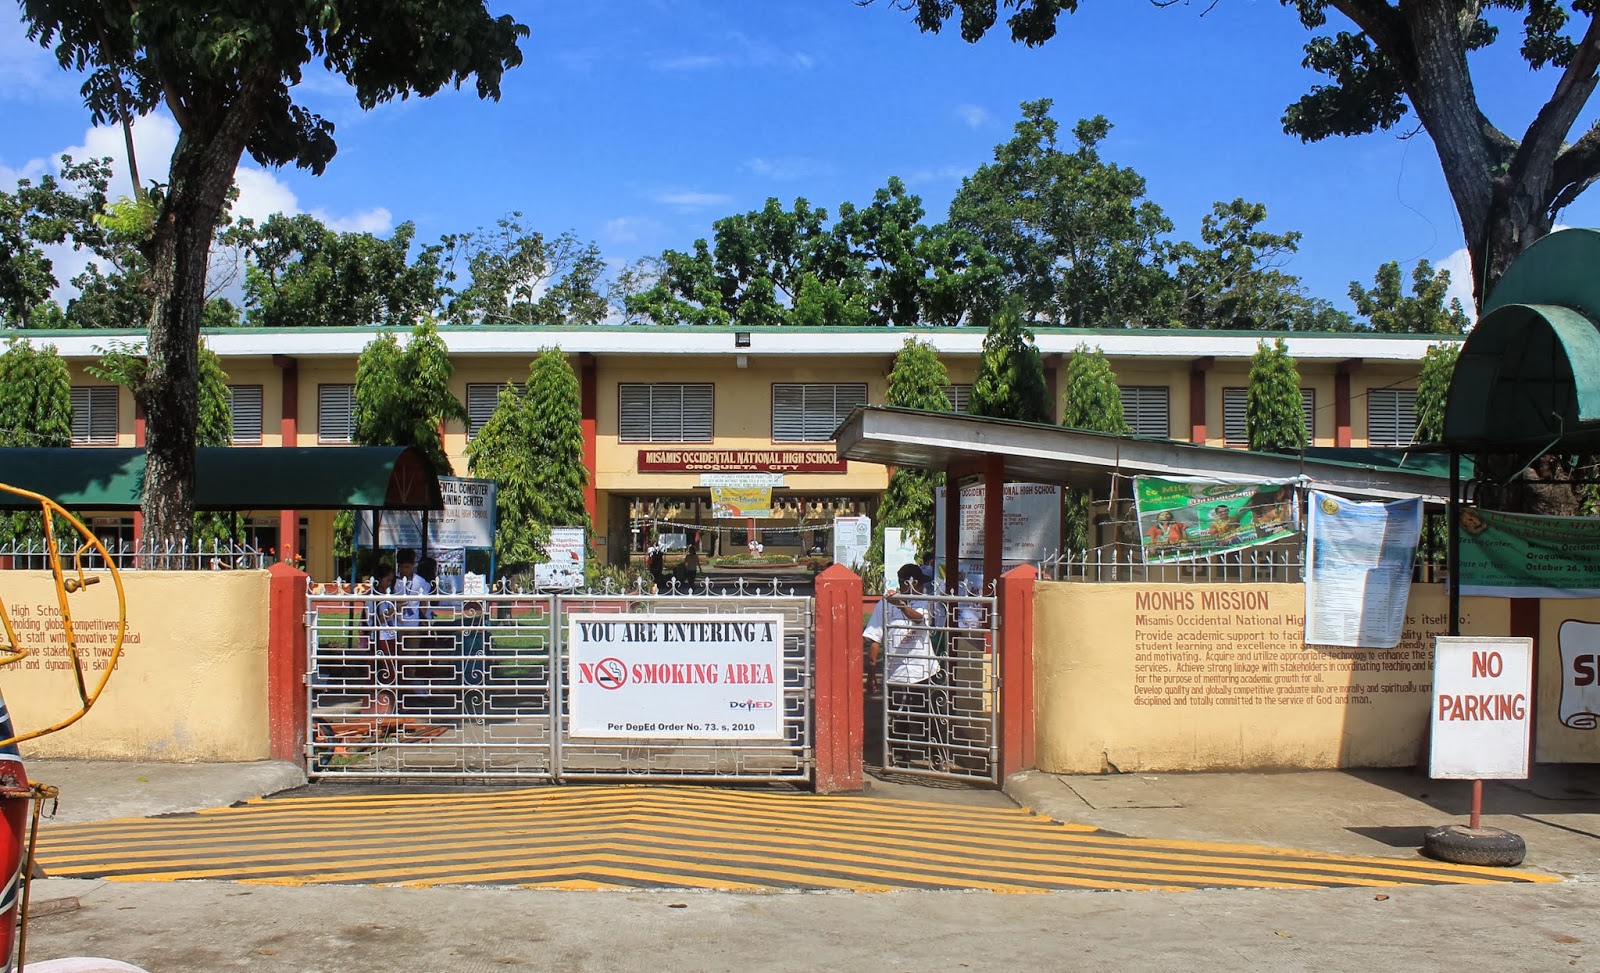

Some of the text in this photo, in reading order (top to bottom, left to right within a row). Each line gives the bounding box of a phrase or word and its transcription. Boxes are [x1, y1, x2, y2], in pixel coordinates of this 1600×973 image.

[646, 451, 839, 464] MISAMIS OCCIDENTAL NATIONAL HIGH SCHOOL
[440, 482, 488, 495] ENTAL COMPUTER
[1034, 486, 1056, 494] SCHOOL
[442, 495, 484, 506] AINING CENTER
[1562, 544, 1600, 552] Occident
[1526, 563, 1563, 572] October
[1136, 591, 1269, 610] MONHS MISSION
[12, 604, 62, 617] High Schoo
[10, 618, 130, 631] pholding globa ompetitivenes
[1136, 615, 1174, 626] Misamis
[1176, 614, 1231, 626] Occidental
[1236, 614, 1282, 626] National
[1286, 614, 1305, 628] Hig
[1422, 614, 1447, 624] itself
[1460, 614, 1470, 624] o:
[26, 632, 46, 643] staff
[50, 632, 66, 643] with
[74, 632, 108, 644] novative
[109, 632, 140, 644] tenical
[580, 622, 773, 642] YOU ARE ENTERING A
[1136, 630, 1172, 640] Provide
[1176, 630, 1224, 640] academic
[1227, 632, 1264, 642] support
[1270, 632, 1279, 640] to
[1282, 630, 1305, 640] facili
[1402, 630, 1422, 644] ality
[43, 646, 90, 657] stakehers
[93, 646, 125, 658] towas
[1136, 642, 1172, 650] student
[1176, 642, 1212, 652] learning
[1216, 642, 1232, 650] and
[1236, 642, 1286, 650] excellence
[1290, 642, 1298, 650] in
[1397, 641, 1428, 650] riendly,
[1136, 652, 1152, 661] and
[1154, 652, 1202, 662] motivating.
[1206, 652, 1234, 662] Acquire
[1236, 652, 1251, 660] and
[1254, 651, 1278, 660] utilize
[1280, 651, 1326, 662] appropriate
[1329, 651, 1366, 662] technology
[1368, 652, 1374, 660] to
[1378, 651, 1409, 660] enhance
[1412, 650, 1425, 660] the
[26, 658, 40, 670] and
[92, 659, 118, 670] skilld
[1134, 664, 1171, 673] services.
[1176, 663, 1204, 672] Achieve
[1207, 664, 1232, 674] strong
[1234, 662, 1260, 674] linkage
[1262, 662, 1278, 672] with
[1280, 662, 1328, 672] stakeholders
[1329, 662, 1335, 672] in
[1336, 661, 1380, 672] coordinating
[1382, 661, 1410, 672] teaching
[1412, 661, 1426, 671] and
[1472, 652, 1503, 678] NO
[632, 663, 718, 684] SMOKING
[724, 664, 774, 684] AREA
[1136, 674, 1324, 685] for the purpose of mentoring academic growth for all.
[1134, 681, 1432, 696] Develop quality and globally competitive graduate who are morally and spiritually upri
[1134, 695, 1372, 706] disciplined and totally committed to the service of God and man.
[1438, 694, 1525, 721] PARKING
[608, 723, 624, 731] Per
[626, 723, 656, 732] DepEd
[658, 723, 684, 731] Order
[686, 723, 702, 731] No.
[704, 723, 719, 731] 73.
[732, 723, 755, 731] 2010
